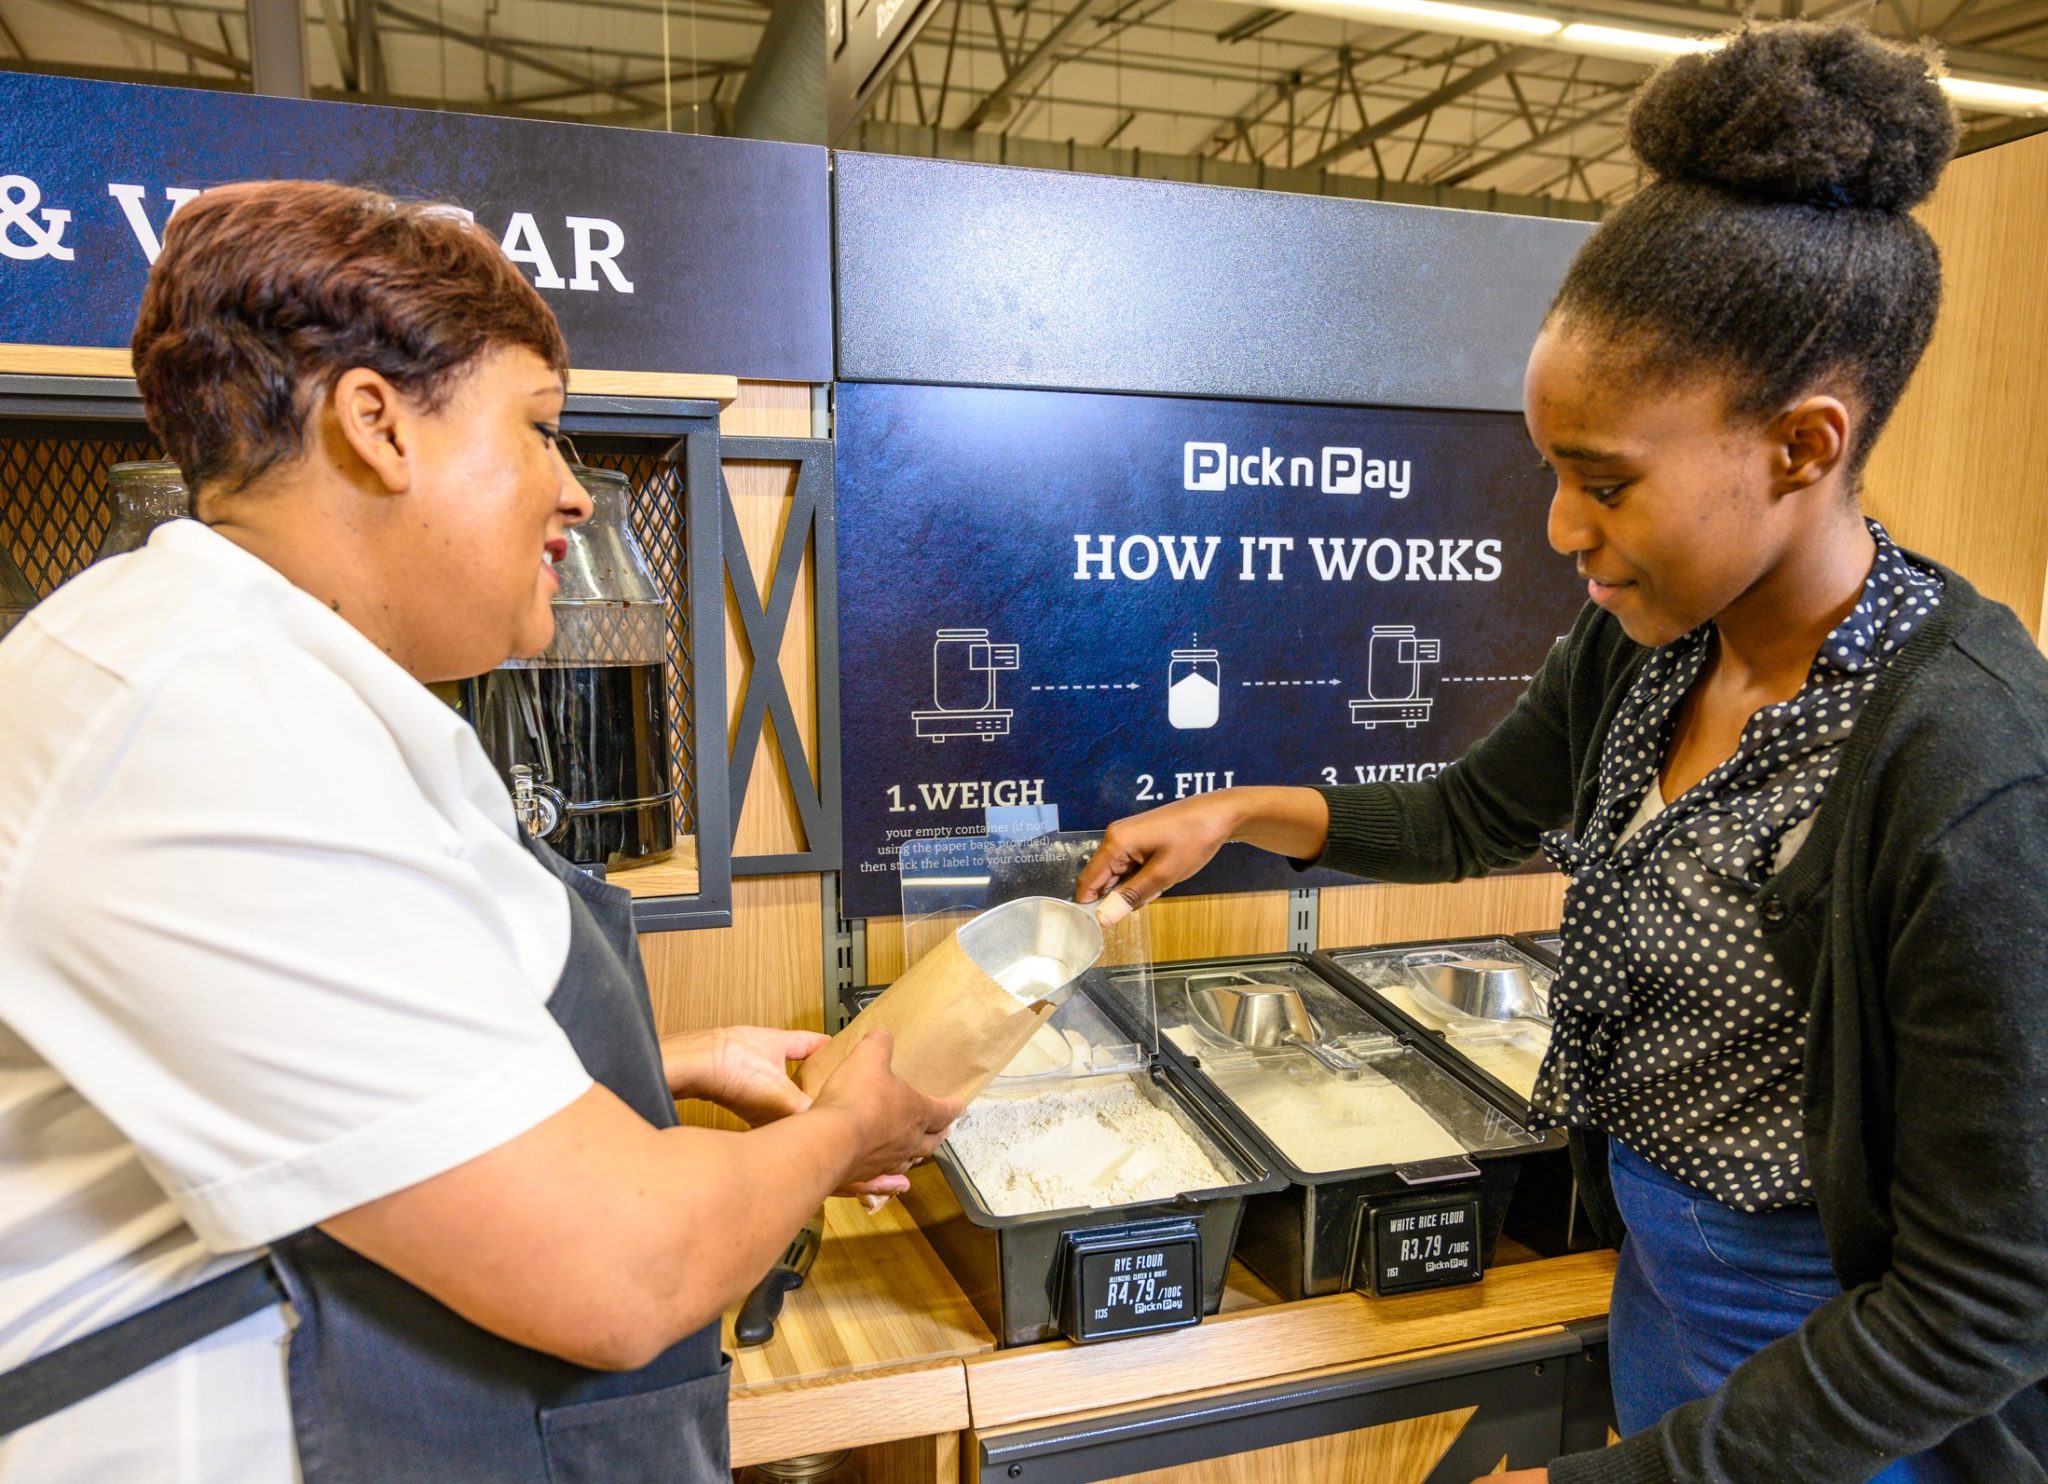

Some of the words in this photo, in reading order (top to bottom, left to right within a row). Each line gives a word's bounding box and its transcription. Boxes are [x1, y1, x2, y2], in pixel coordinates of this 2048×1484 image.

[0, 174, 75, 262] &
[1321, 446, 1411, 499] Pay
[1073, 534, 1221, 581] HOW
[1239, 536, 1294, 581] IT
[1308, 537, 1502, 582] WORKS
[1355, 762, 1457, 784] WEIG
[1136, 774, 1164, 801] 2.
[886, 829, 913, 841] your
[915, 827, 952, 839] empty
[955, 823, 1009, 835] container
[878, 844, 910, 856] using
[913, 843, 931, 853] the
[934, 842, 968, 855] paper
[970, 840, 996, 852] bags
[860, 861, 887, 872] then
[890, 859, 918, 870] stick
[921, 858, 939, 869] the
[942, 856, 970, 867] label
[973, 857, 984, 866] to
[986, 856, 1012, 868] your
[1390, 1217, 1416, 1233] WHITE
[1418, 1214, 1437, 1229] RICE
[1440, 1210, 1464, 1226] FLOUR
[1114, 1257, 1132, 1272] RYE
[1135, 1253, 1164, 1270] FLOUR
